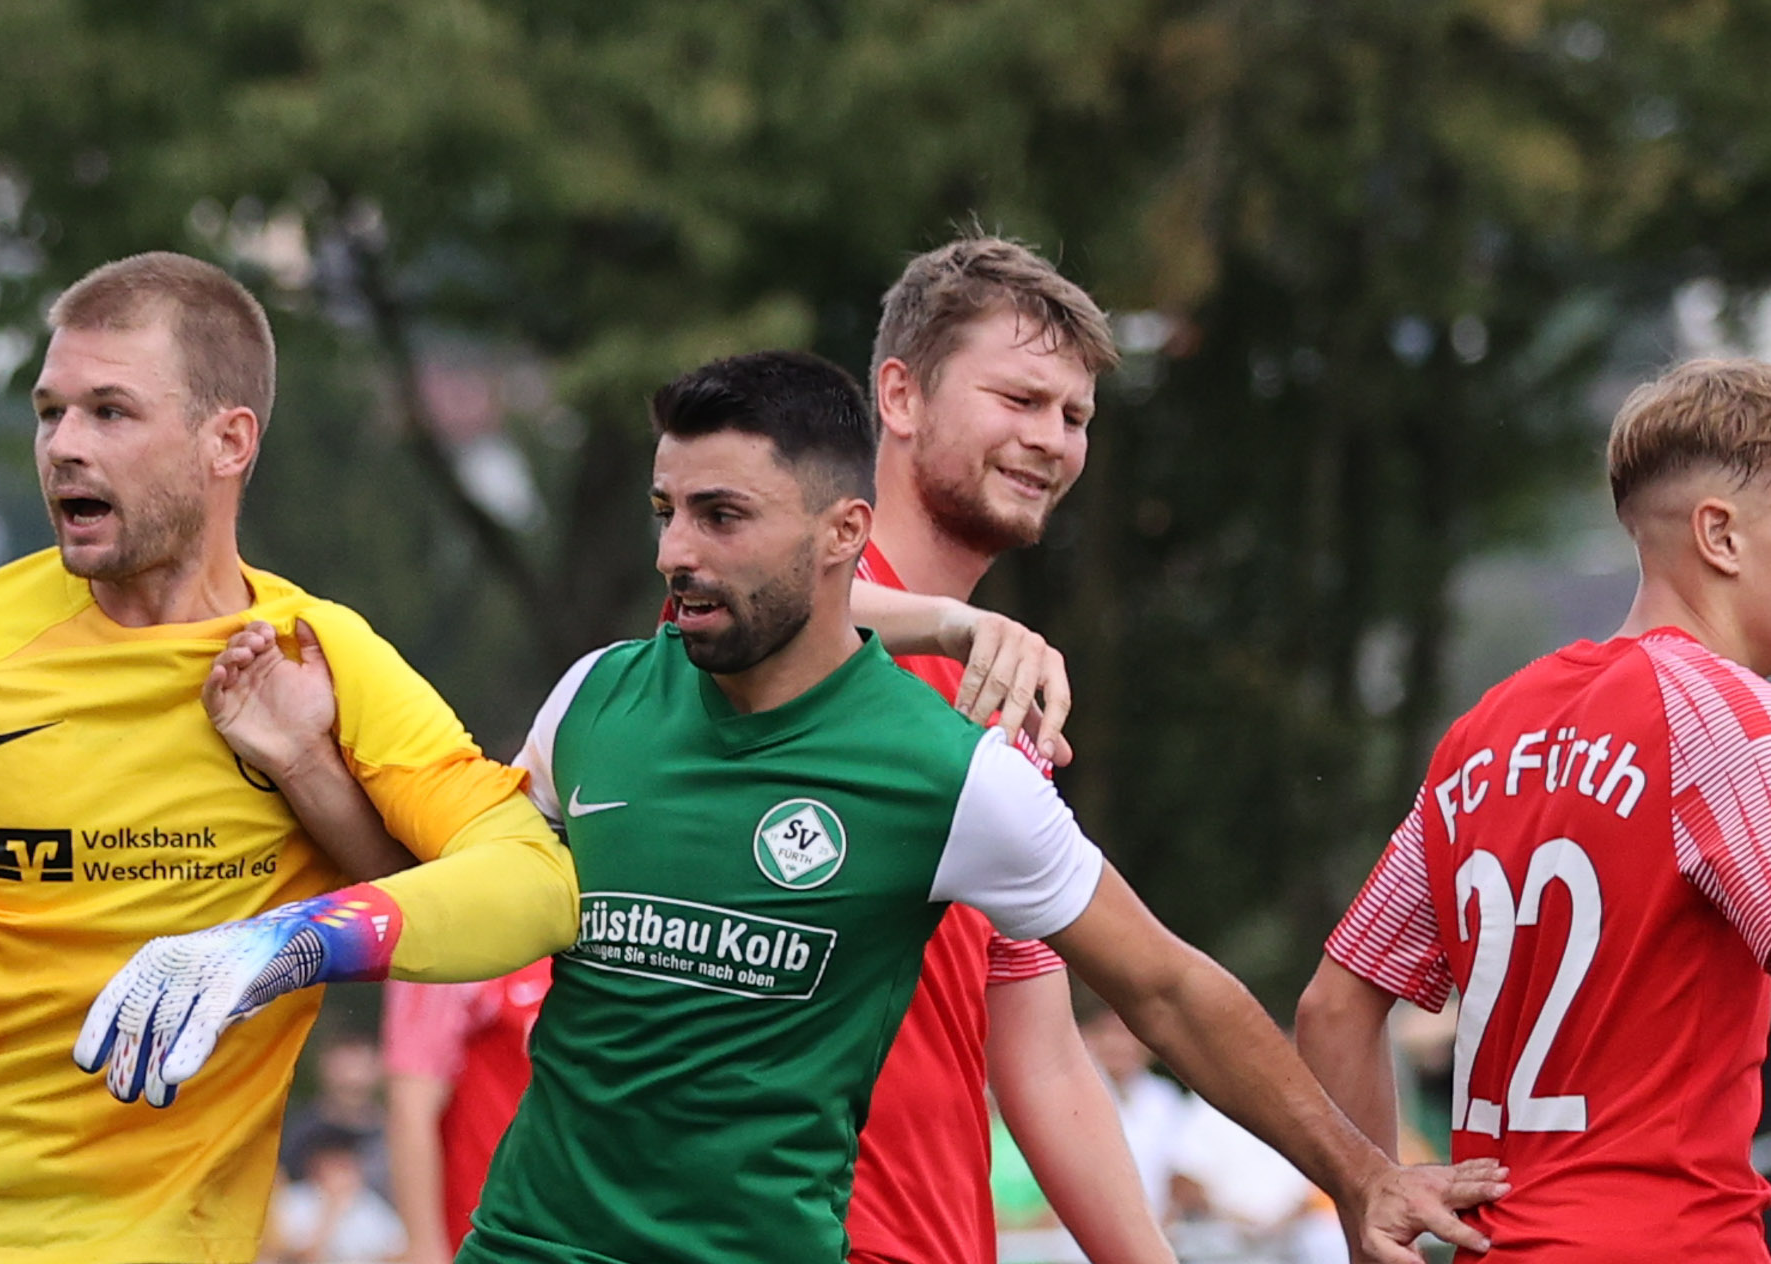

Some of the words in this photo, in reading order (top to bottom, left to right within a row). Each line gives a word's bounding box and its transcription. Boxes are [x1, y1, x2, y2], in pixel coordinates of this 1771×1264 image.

[1435, 748, 1496, 844] FC
[1505, 726, 1647, 820] Fürth
[82, 827, 217, 850] Volksbank
[783, 819, 822, 851] SV
[83, 858, 244, 882] Weschnitztal
[251, 855, 278, 877] eG
[778, 847, 814, 865] FÜRTH
[577, 901, 712, 955] rüstbau
[716, 918, 811, 972] Kolb
[623, 945, 646, 965] Sie
[649, 951, 695, 972] sicher
[698, 961, 734, 981] nach
[737, 968, 776, 988] oben
[1451, 836, 1604, 1140] 22
